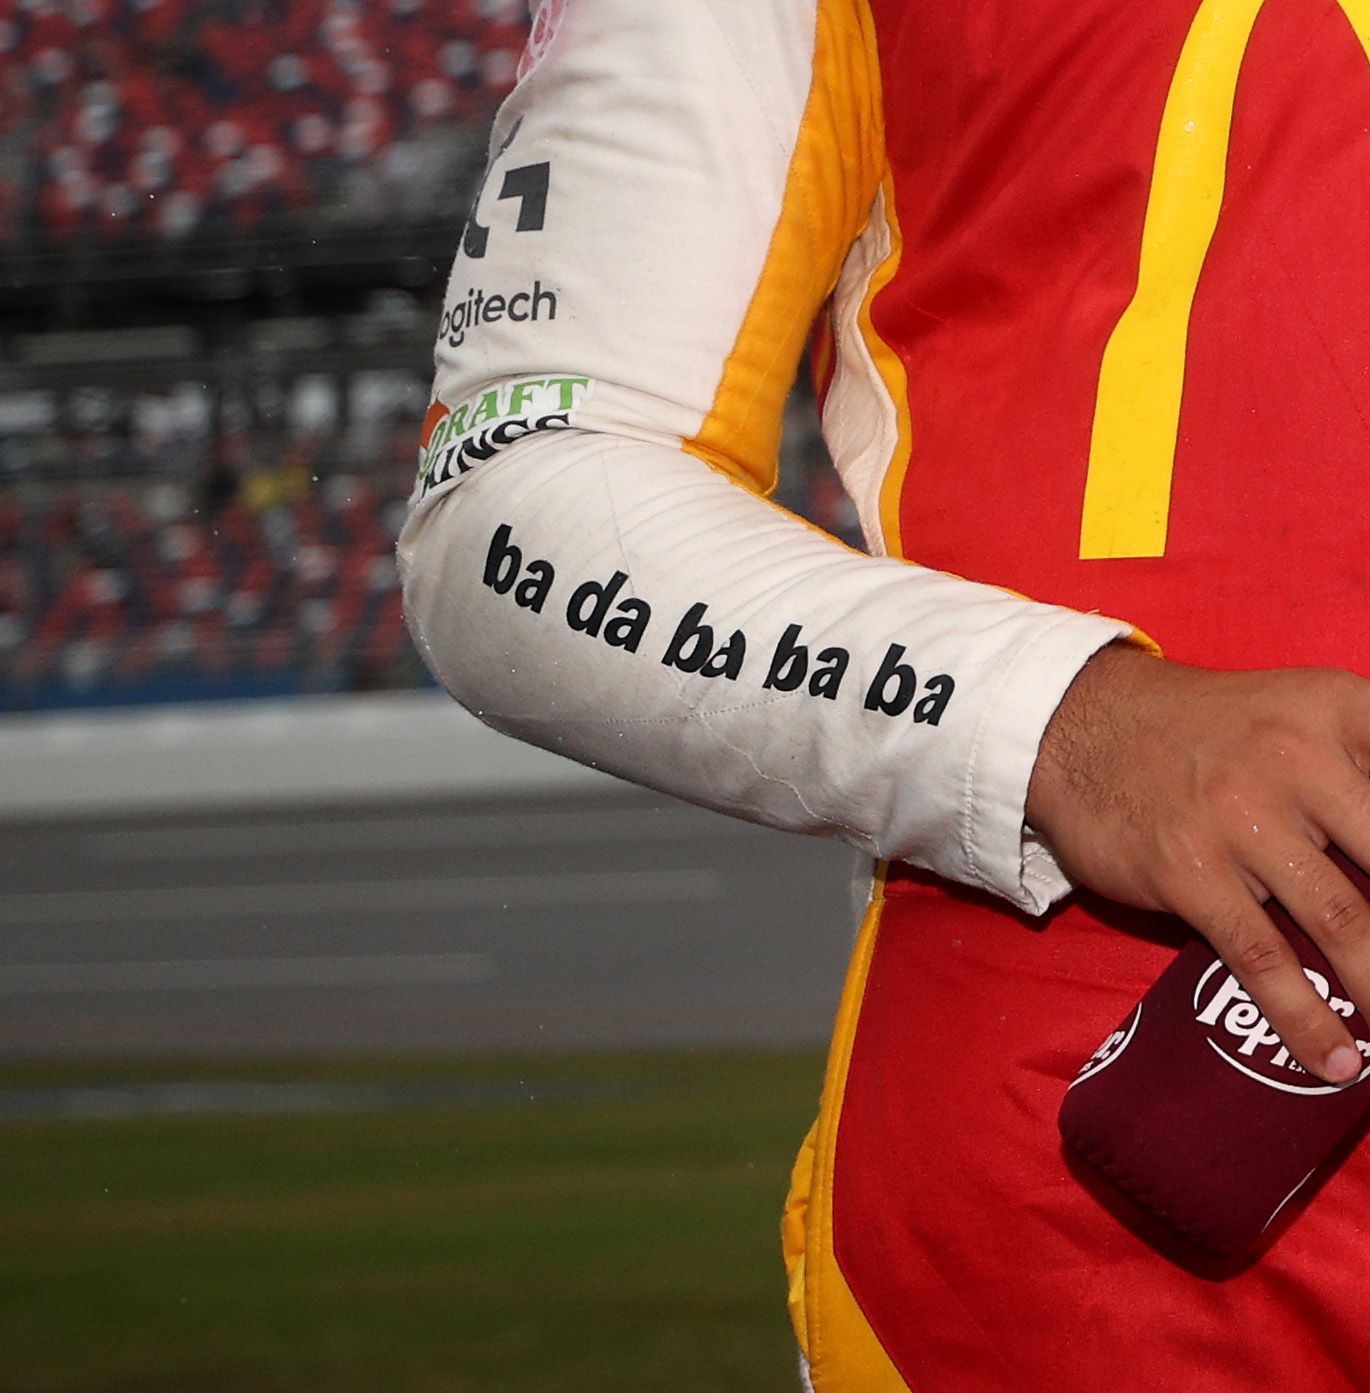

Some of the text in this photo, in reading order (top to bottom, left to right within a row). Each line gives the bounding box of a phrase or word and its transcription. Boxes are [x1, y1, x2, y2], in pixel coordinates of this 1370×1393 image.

[417, 378, 589, 481] DRAFT
[482, 524, 956, 727] ba da ba ba ba
